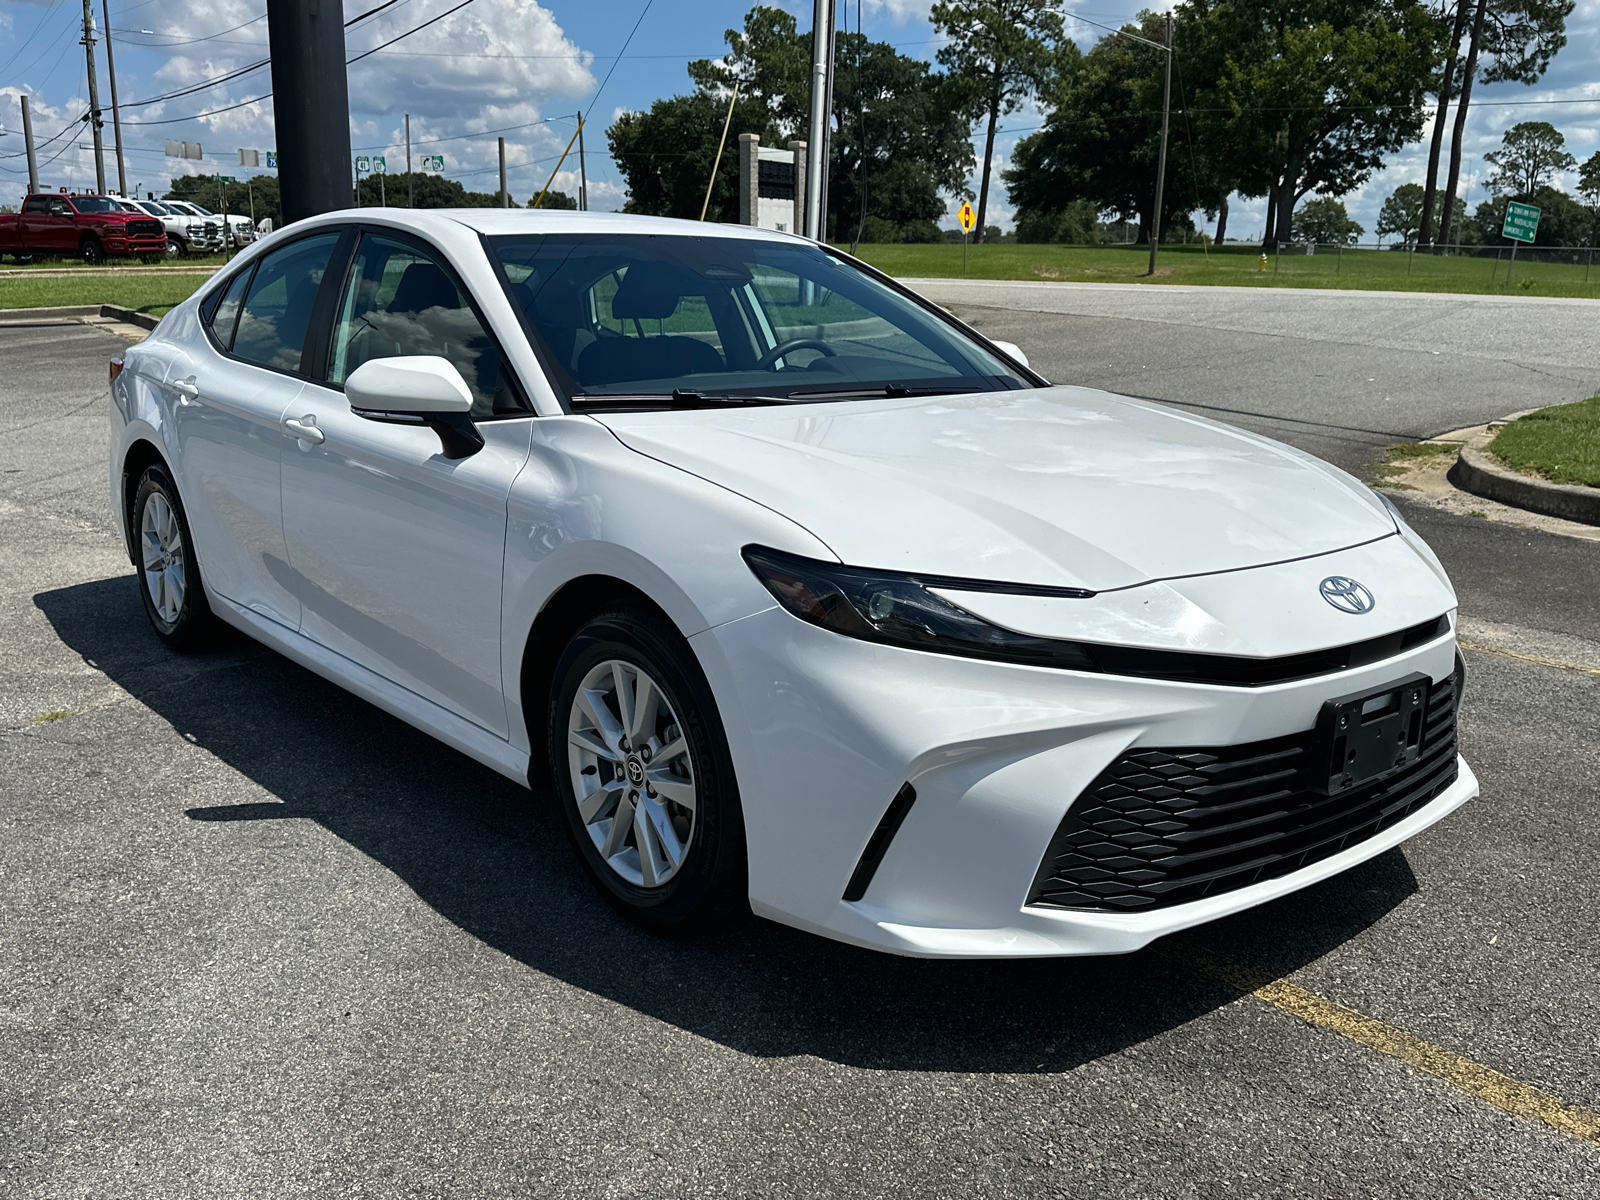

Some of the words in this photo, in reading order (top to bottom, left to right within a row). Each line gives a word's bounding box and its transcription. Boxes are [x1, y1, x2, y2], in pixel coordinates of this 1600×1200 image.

[269, 158, 277, 167] 75
[360, 162, 366, 170] 41
[688, 709, 716, 828] VELOCITY
[701, 829, 716, 876] TOURING
